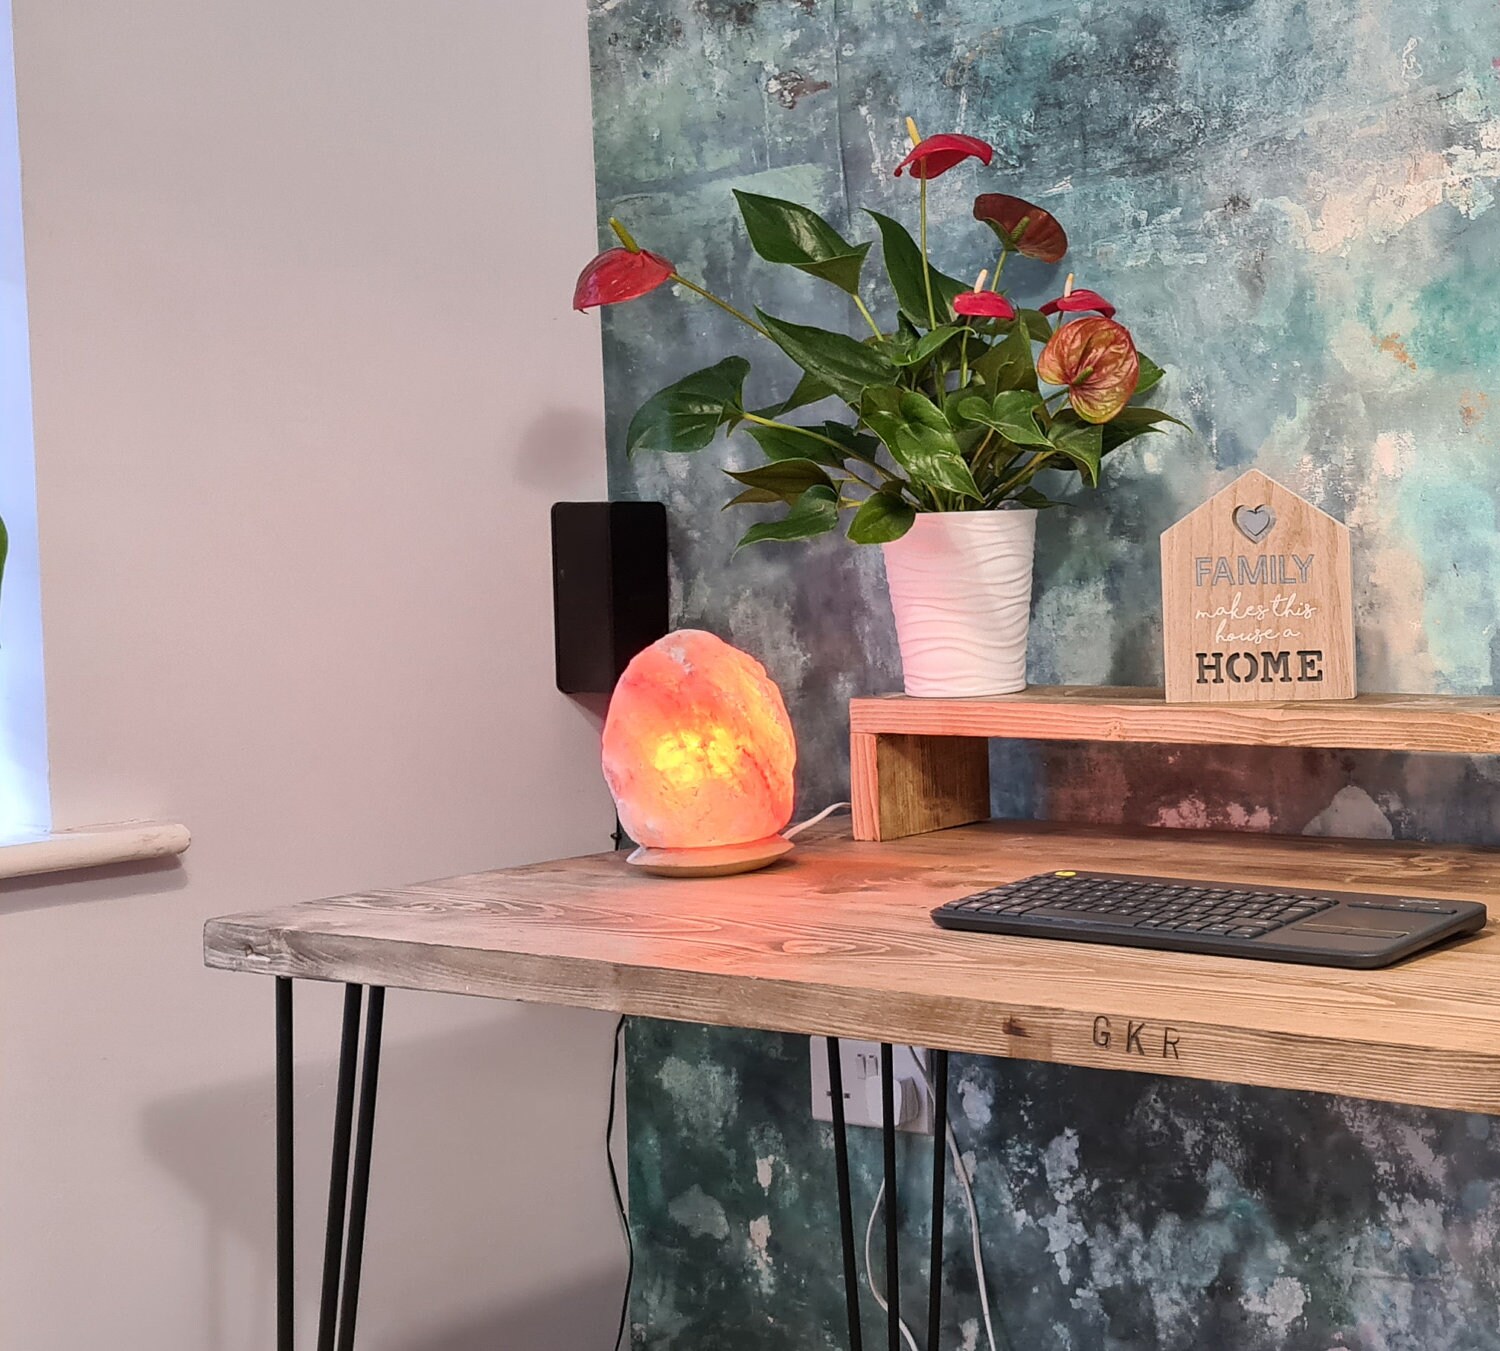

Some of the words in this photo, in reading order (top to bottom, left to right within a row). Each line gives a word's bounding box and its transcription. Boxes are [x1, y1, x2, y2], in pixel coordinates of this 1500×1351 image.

[1195, 554, 1315, 586] FAMILY
[1195, 591, 1269, 621] makes
[1269, 592, 1317, 619] this
[1215, 618, 1281, 644] house
[1282, 628, 1302, 638] a
[1195, 650, 1324, 684] HOME
